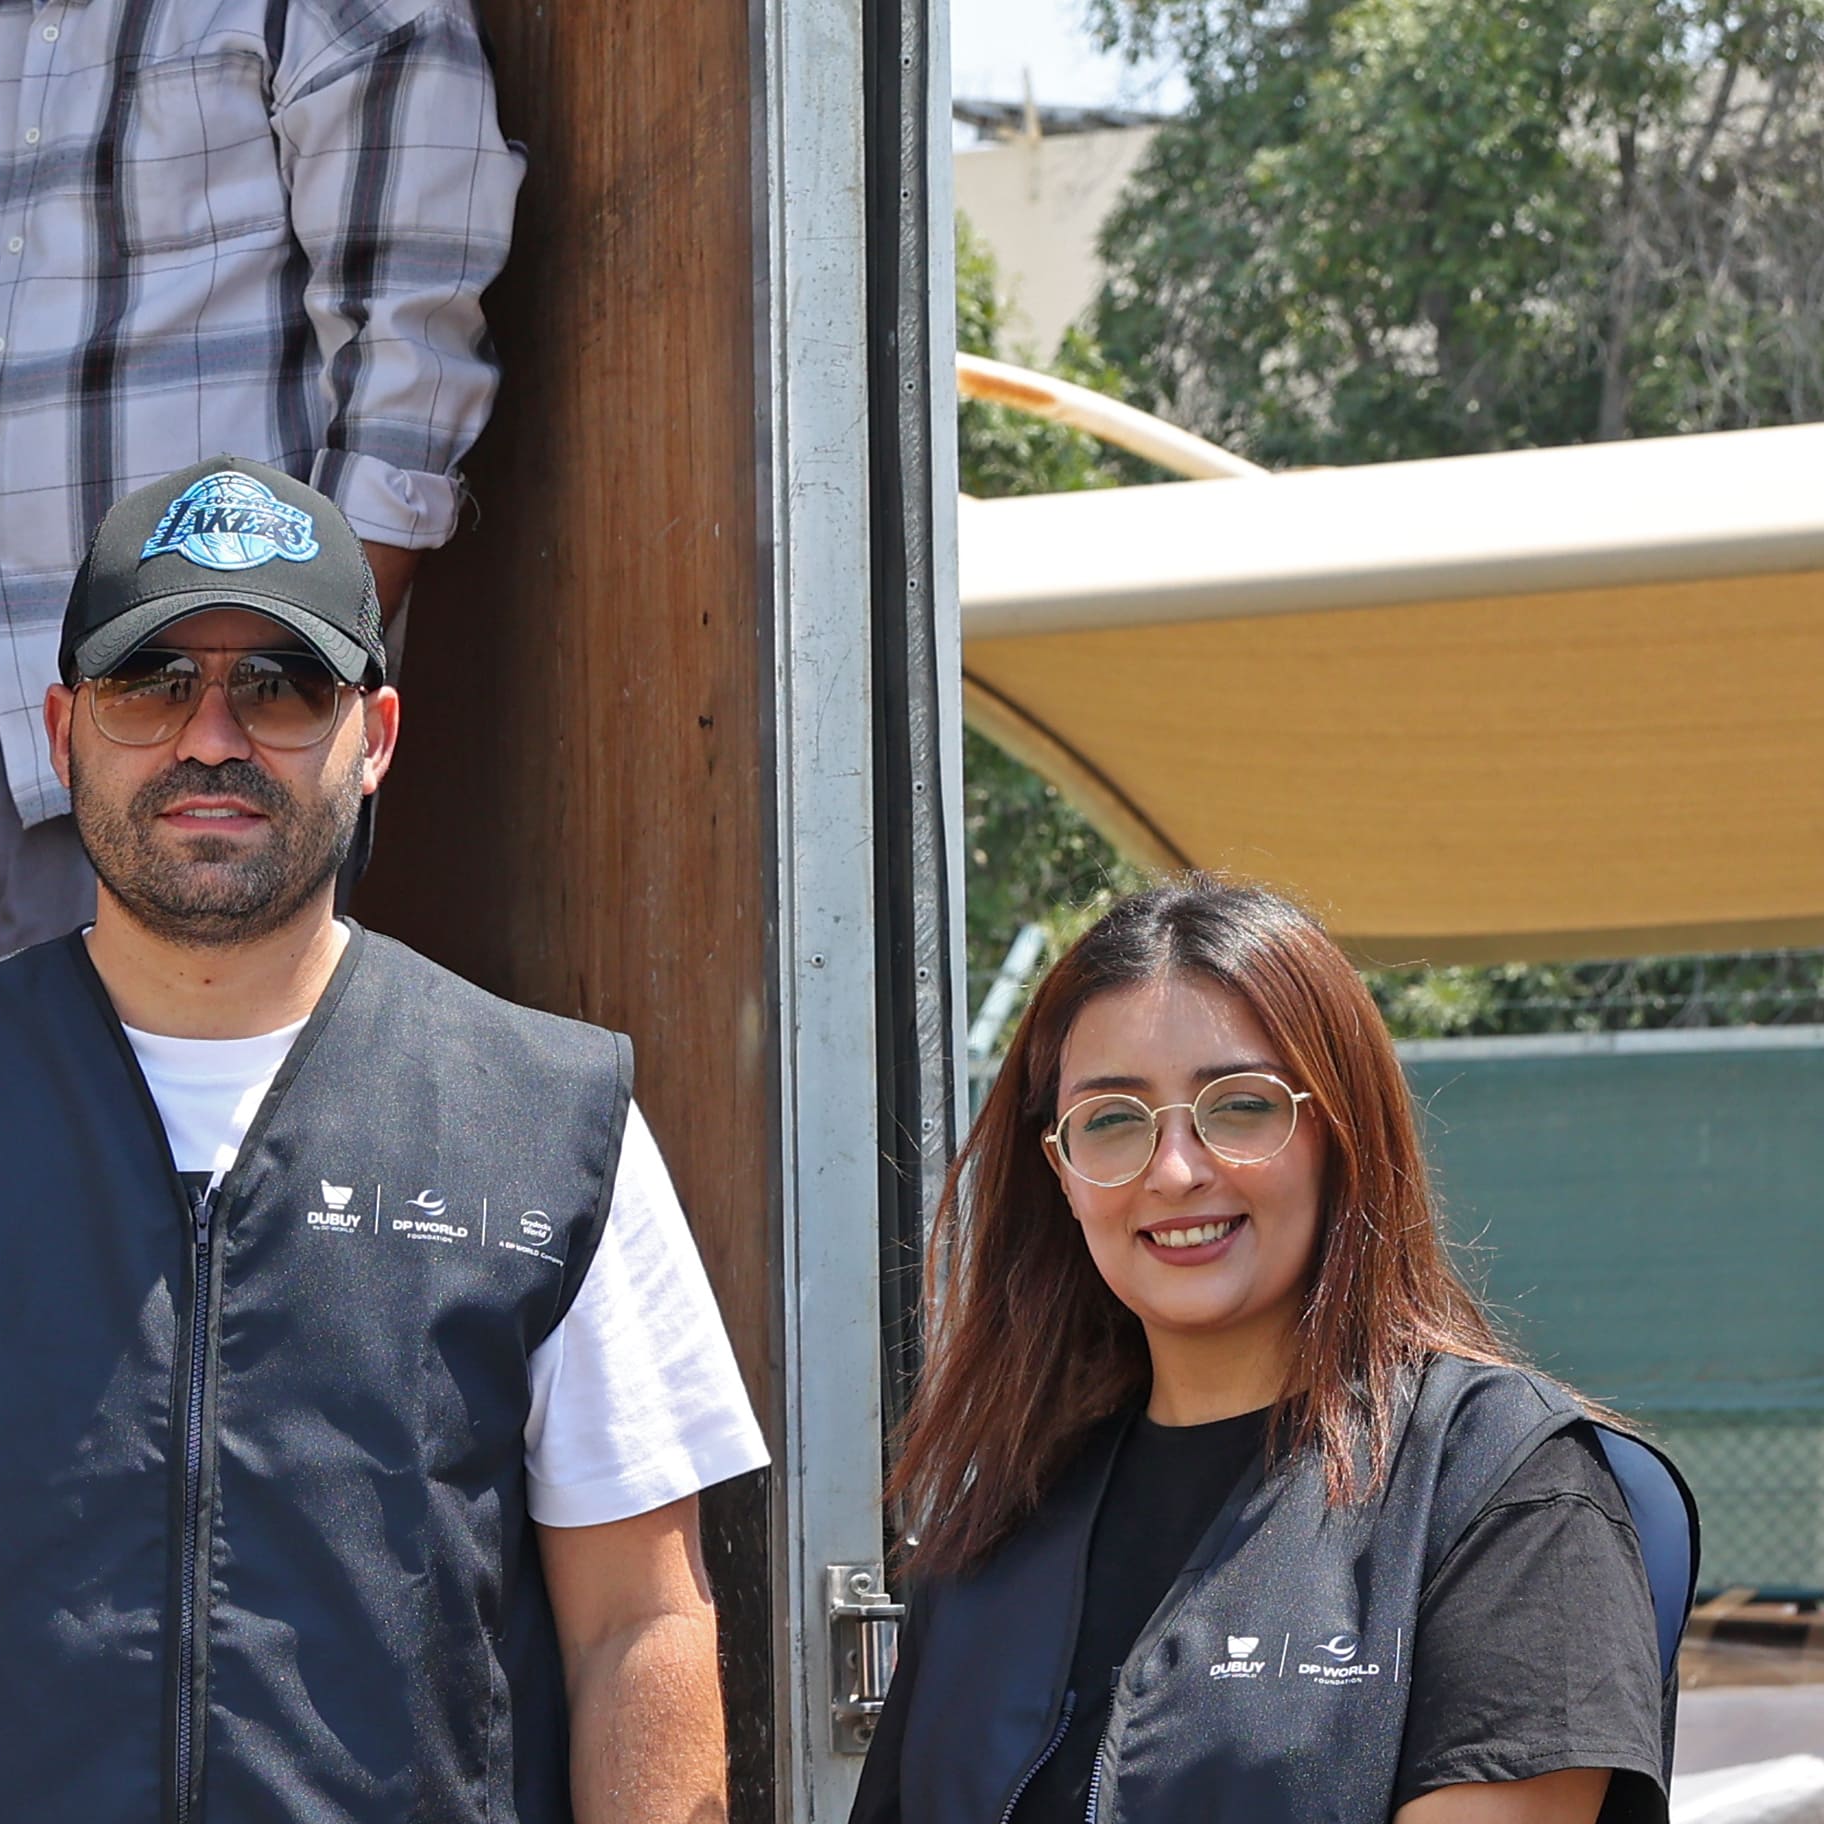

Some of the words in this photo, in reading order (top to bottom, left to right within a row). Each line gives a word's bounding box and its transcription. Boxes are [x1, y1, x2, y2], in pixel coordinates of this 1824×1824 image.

[160, 500, 306, 552] LAKERS
[307, 1212, 361, 1227] DUBUY
[392, 1220, 413, 1231] DP
[414, 1221, 468, 1238] WORLD
[407, 1233, 453, 1244] FOUNDATION
[1209, 1661, 1265, 1677] DUBUY
[1298, 1664, 1320, 1674] DP
[1322, 1664, 1379, 1678] WORLD
[1313, 1677, 1362, 1686] FOUNDATION
